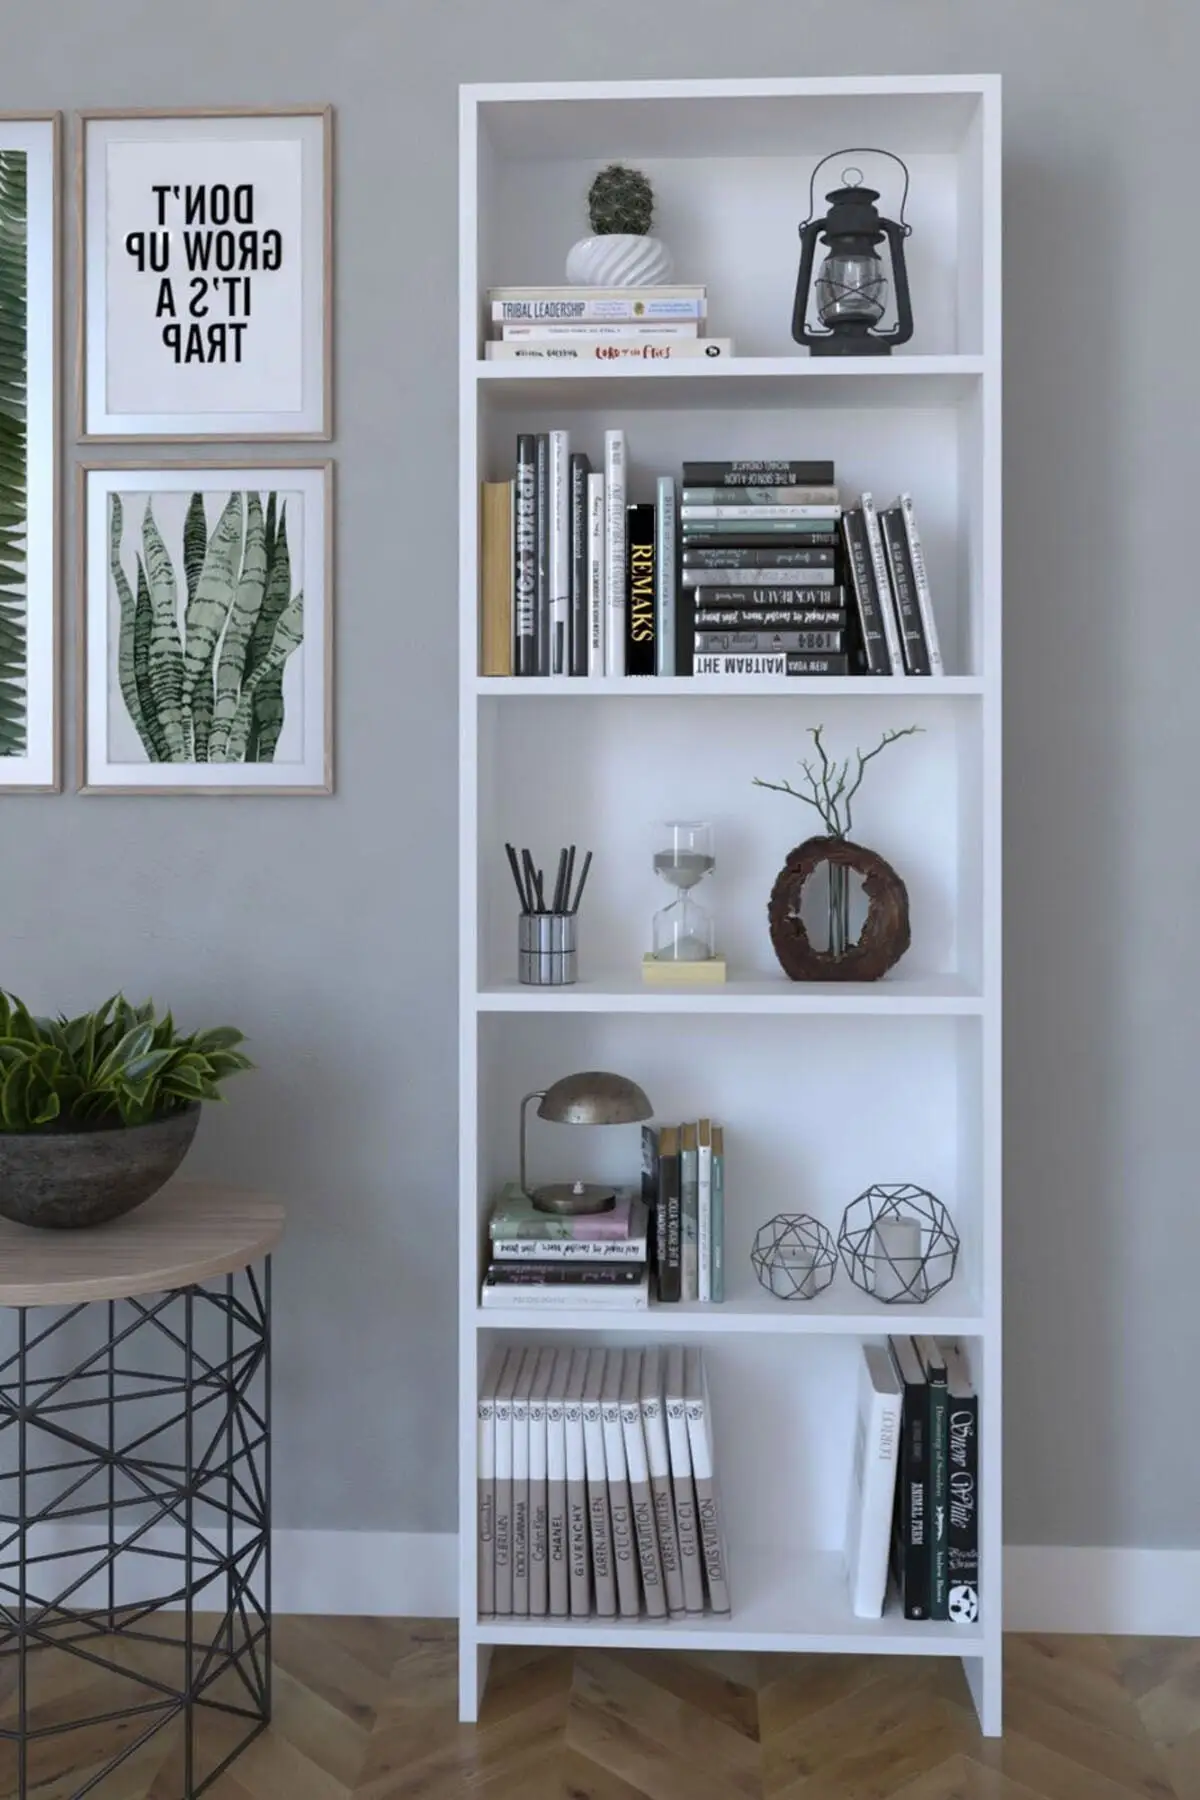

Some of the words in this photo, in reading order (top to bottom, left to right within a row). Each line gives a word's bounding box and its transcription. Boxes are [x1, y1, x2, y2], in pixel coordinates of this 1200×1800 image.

[502, 302, 532, 318] TRIBAL
[535, 302, 585, 318] LEADERSHIP
[631, 544, 653, 642] REMAKS
[753, 590, 793, 604] BEAUTY
[795, 590, 831, 604] BLACK
[950, 1411, 974, 1467] Snow
[592, 1497, 606, 1538] MILLEN
[656, 1492, 673, 1534] MILLEN
[911, 1482, 923, 1518] ANIMAL
[950, 1472, 974, 1529] White
[552, 1514, 563, 1561] CHANEL
[572, 1504, 585, 1577] GIVENCHY
[614, 1505, 629, 1561] GUCCI
[635, 1502, 656, 1551] VUITTON
[679, 1502, 697, 1557] GUCCI
[700, 1498, 717, 1548] VUITTON
[911, 1520, 923, 1545] FARM
[595, 1541, 609, 1577] KAREN
[641, 1552, 659, 1586] LOUIS
[663, 1536, 677, 1572] KAREN
[706, 1550, 722, 1582] LOUIS
